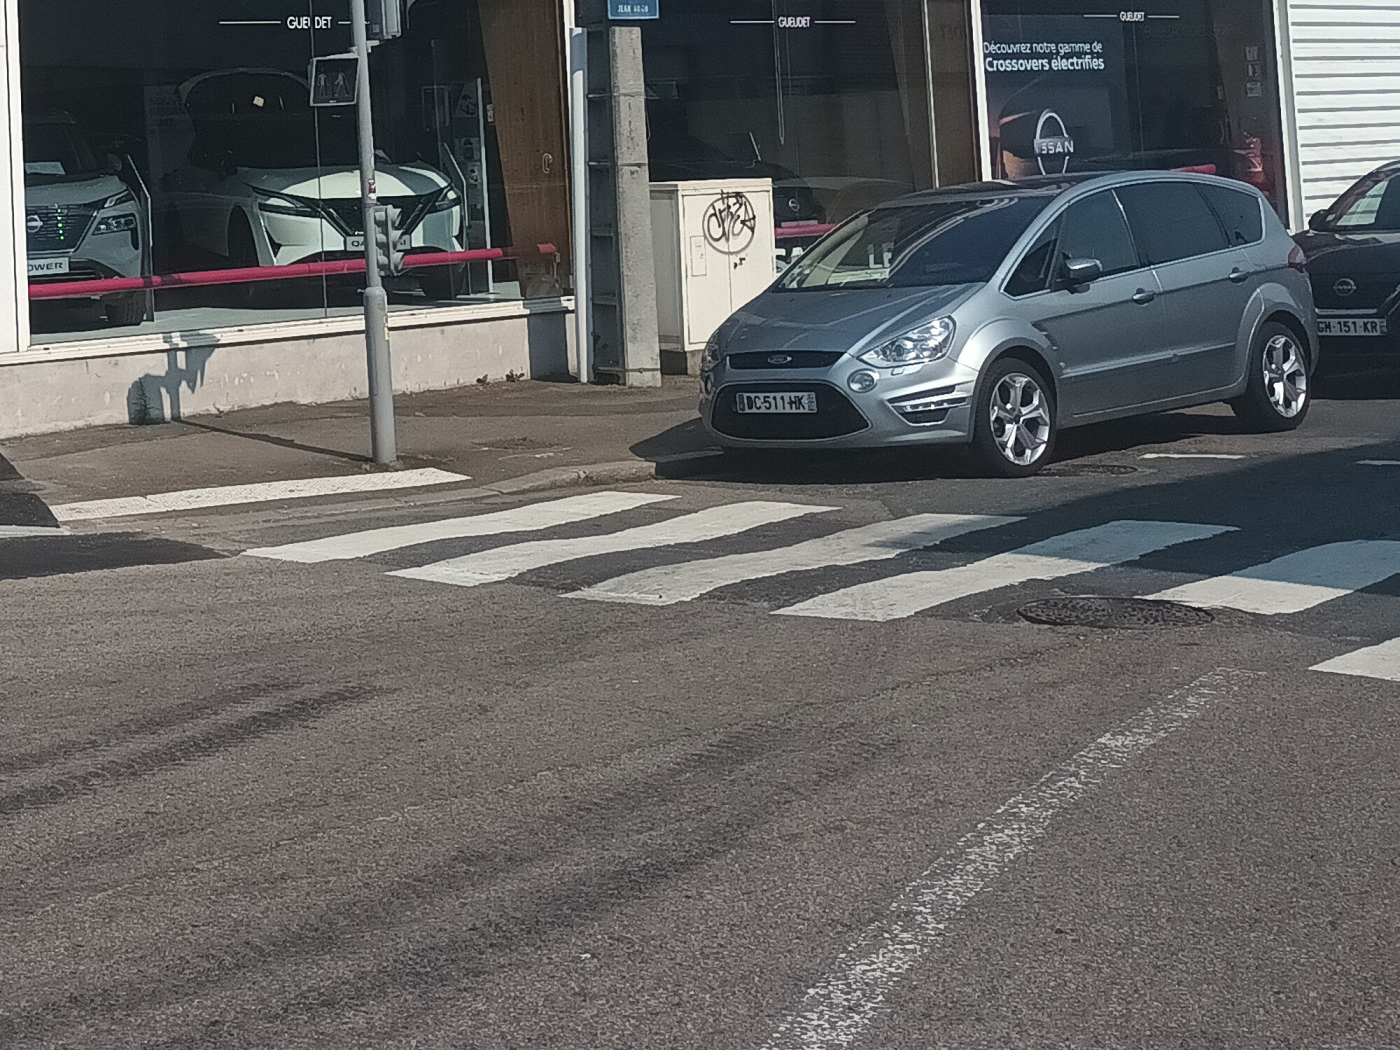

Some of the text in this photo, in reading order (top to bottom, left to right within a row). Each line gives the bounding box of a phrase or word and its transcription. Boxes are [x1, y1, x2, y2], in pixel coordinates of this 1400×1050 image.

[778, 16, 811, 28] GUEUDET
[983, 41, 1103, 55] Découvrez notre gamme de
[985, 54, 1105, 71] Crossovers électrifiés
